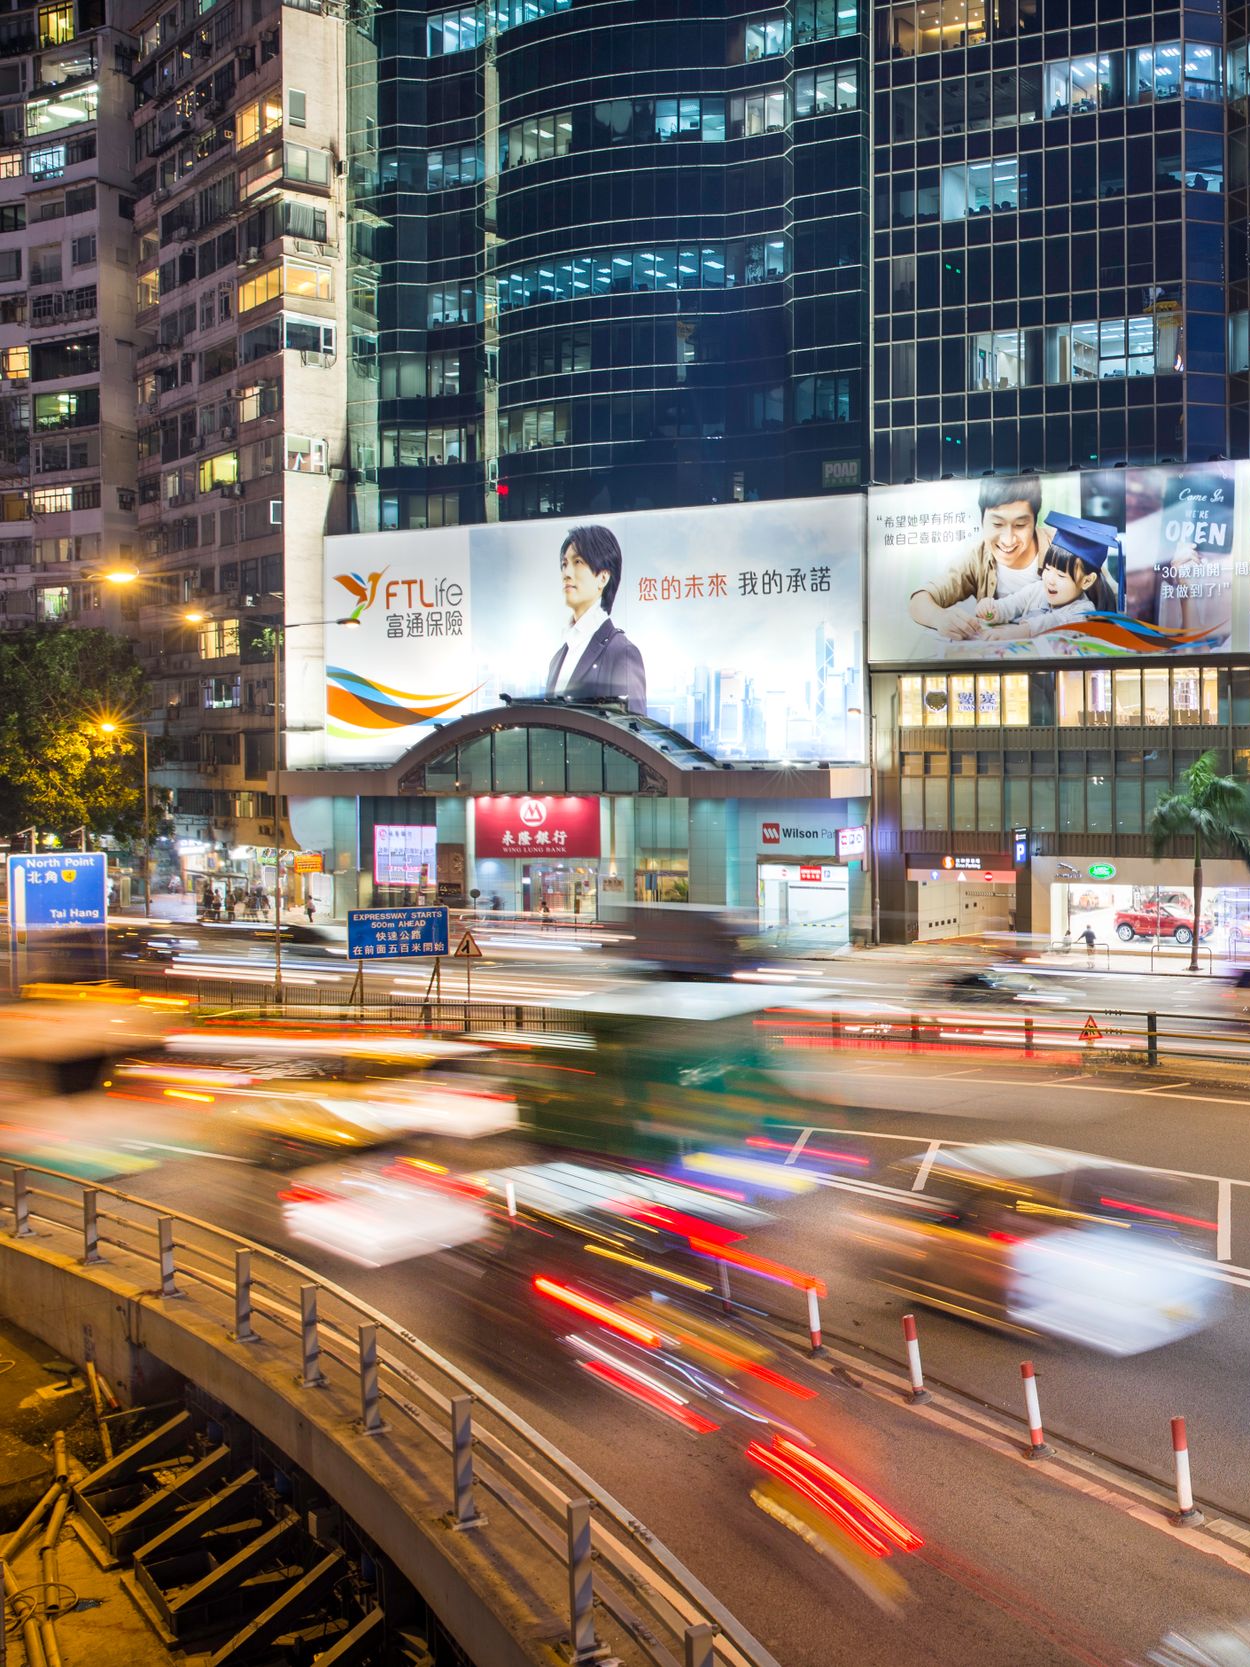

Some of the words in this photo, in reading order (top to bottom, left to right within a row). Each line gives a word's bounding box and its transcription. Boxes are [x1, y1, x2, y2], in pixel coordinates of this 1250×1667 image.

[825, 462, 857, 478] POAD
[1178, 488, 1207, 502] Come
[1165, 520, 1227, 546] OPEN
[638, 573, 728, 601] 您的未來
[738, 566, 831, 596] 我的承諾
[385, 577, 463, 609] FTLife
[386, 610, 463, 638] 富通保險
[502, 830, 568, 846] 永隆銀行
[782, 828, 818, 839] Wilson
[1016, 844, 1025, 861] P
[26, 858, 60, 868] North
[65, 857, 95, 867] Point
[27, 870, 58, 884] 北角
[50, 909, 66, 918] Tai
[70, 908, 99, 918] Hang
[353, 912, 407, 921] EXPRESSWAY
[411, 911, 442, 919] STARTS
[371, 921, 395, 929] 500m
[398, 920, 426, 928] AHEAD
[376, 930, 421, 941] 快速公路
[353, 942, 444, 955] 在前面五百米開始
